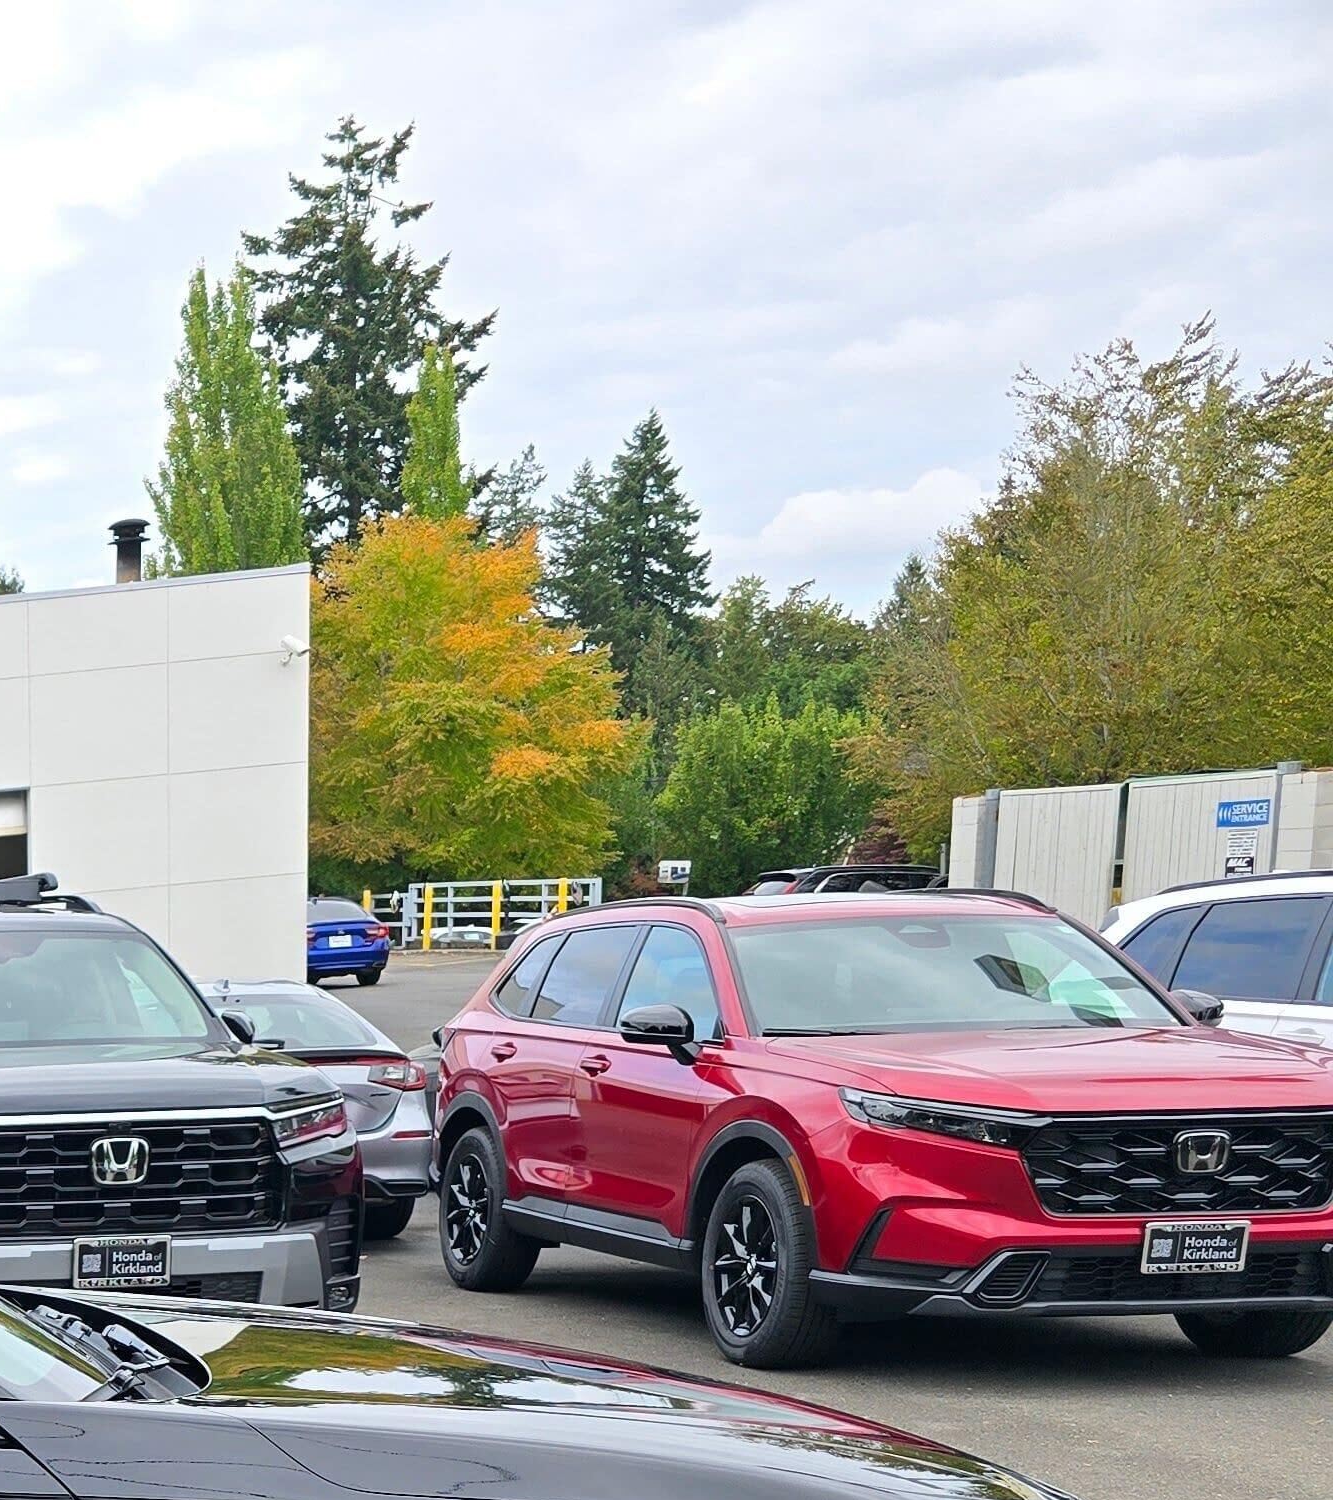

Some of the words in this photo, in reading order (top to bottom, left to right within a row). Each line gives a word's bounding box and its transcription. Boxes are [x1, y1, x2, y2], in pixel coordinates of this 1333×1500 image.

[1232, 803, 1268, 814] SERVICE
[1231, 814, 1267, 822] ENTRANCE
[1227, 858, 1250, 867] MAC
[1172, 1224, 1226, 1232] HONDA
[99, 1239, 147, 1247] HONDA
[1184, 1235, 1227, 1247] Honda
[1228, 1238, 1238, 1247] of
[112, 1250, 153, 1262] Honda
[153, 1252, 163, 1261] of
[1183, 1248, 1237, 1260] Kirkland
[112, 1262, 163, 1274] Kirkland
